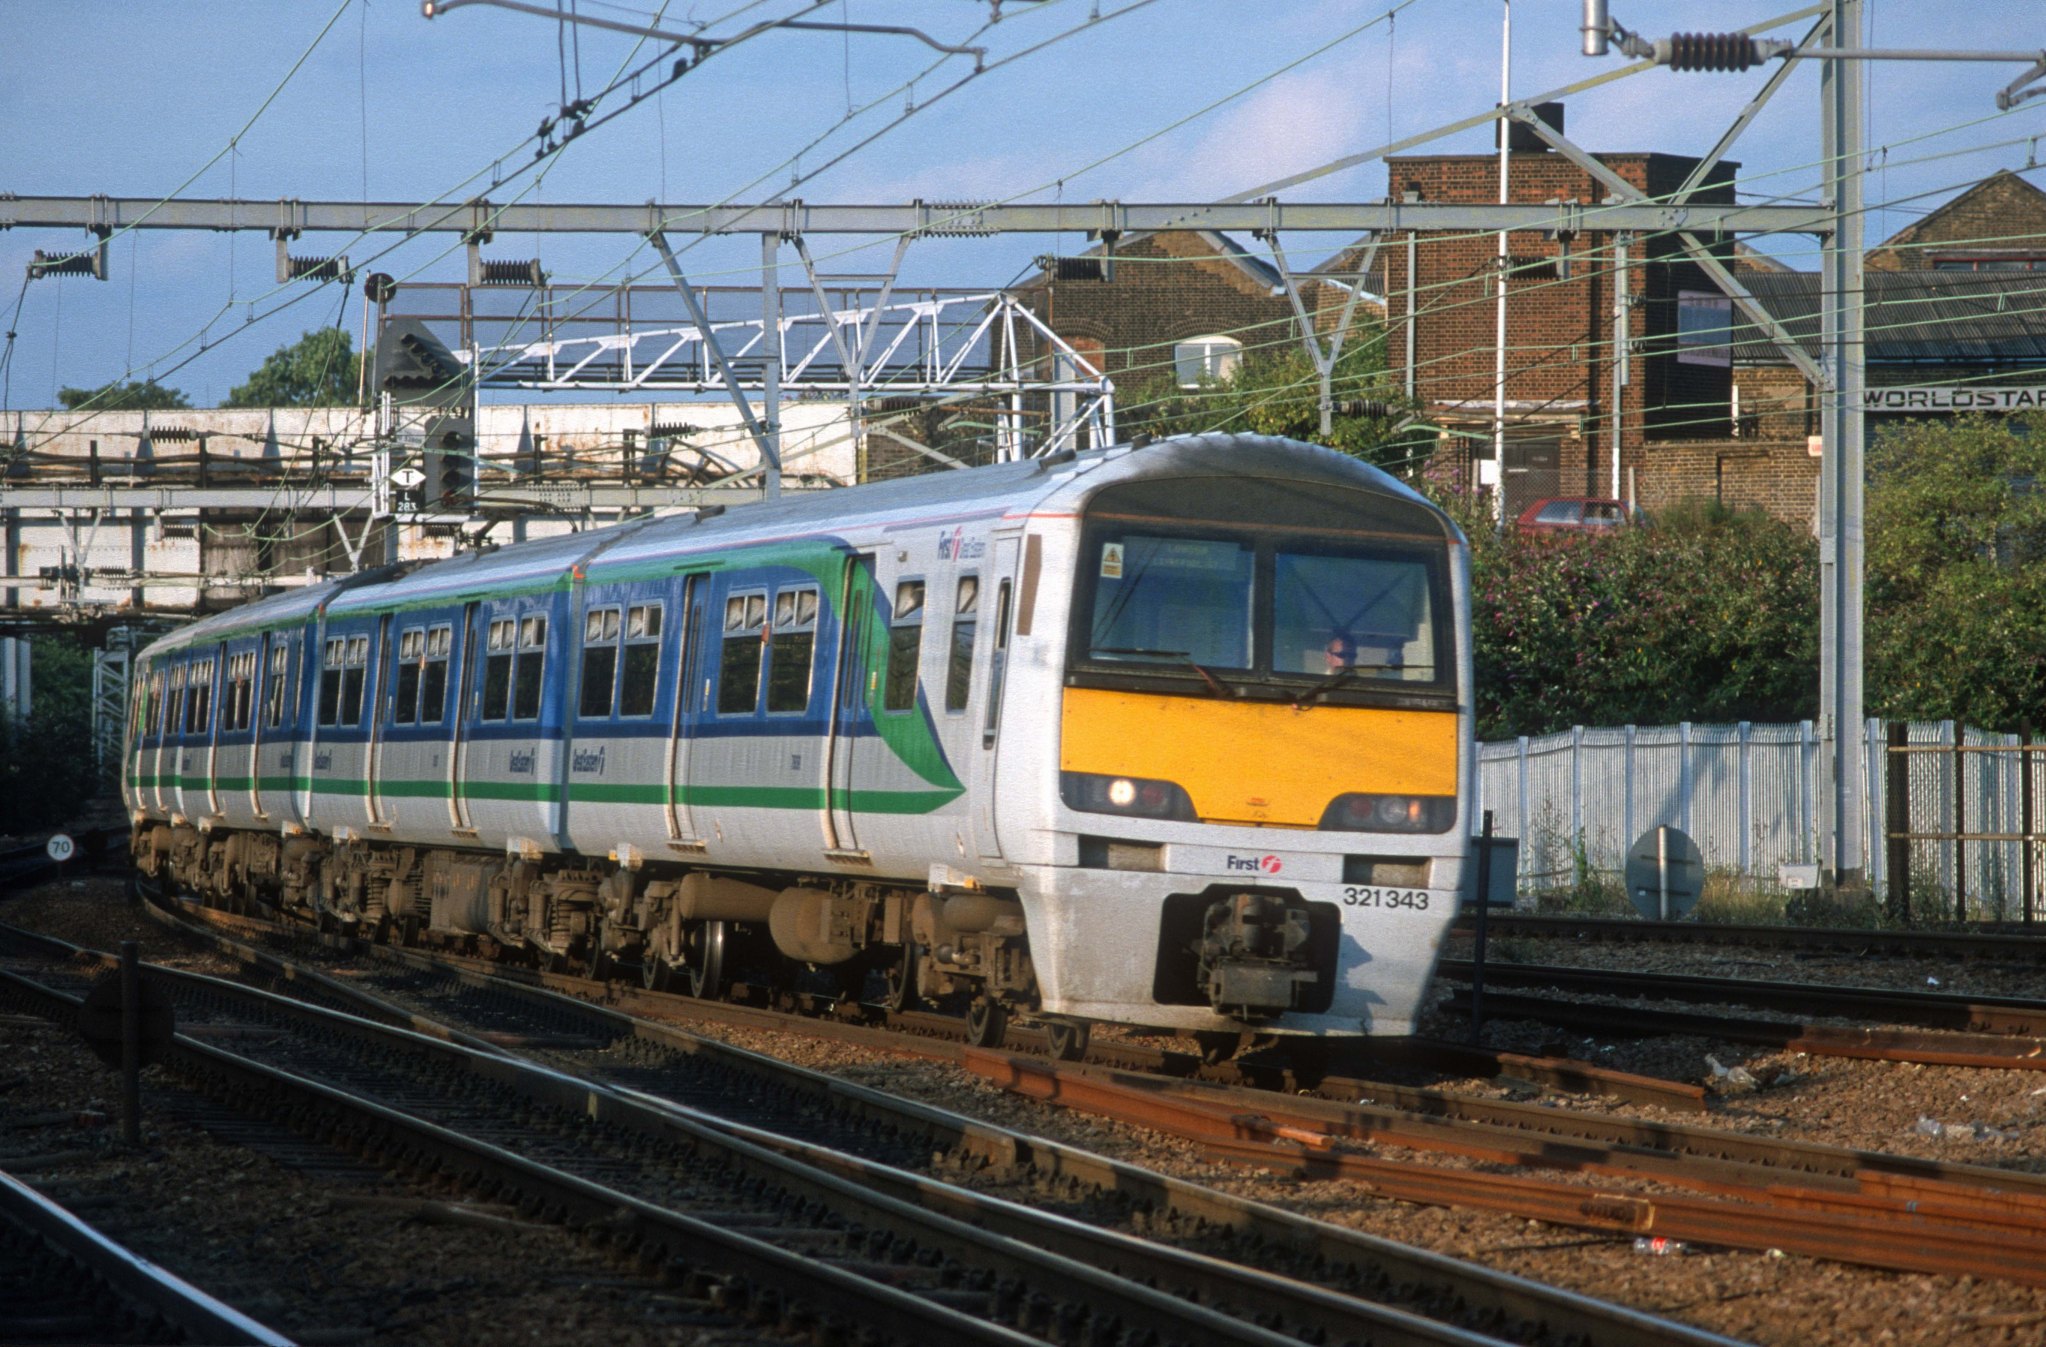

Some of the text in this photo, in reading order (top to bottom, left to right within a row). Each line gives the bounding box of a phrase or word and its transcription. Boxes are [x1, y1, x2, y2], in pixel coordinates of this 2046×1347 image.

[402, 470, 414, 484] T
[404, 492, 410, 501] L
[52, 841, 70, 854] 70
[1226, 855, 1259, 871] First
